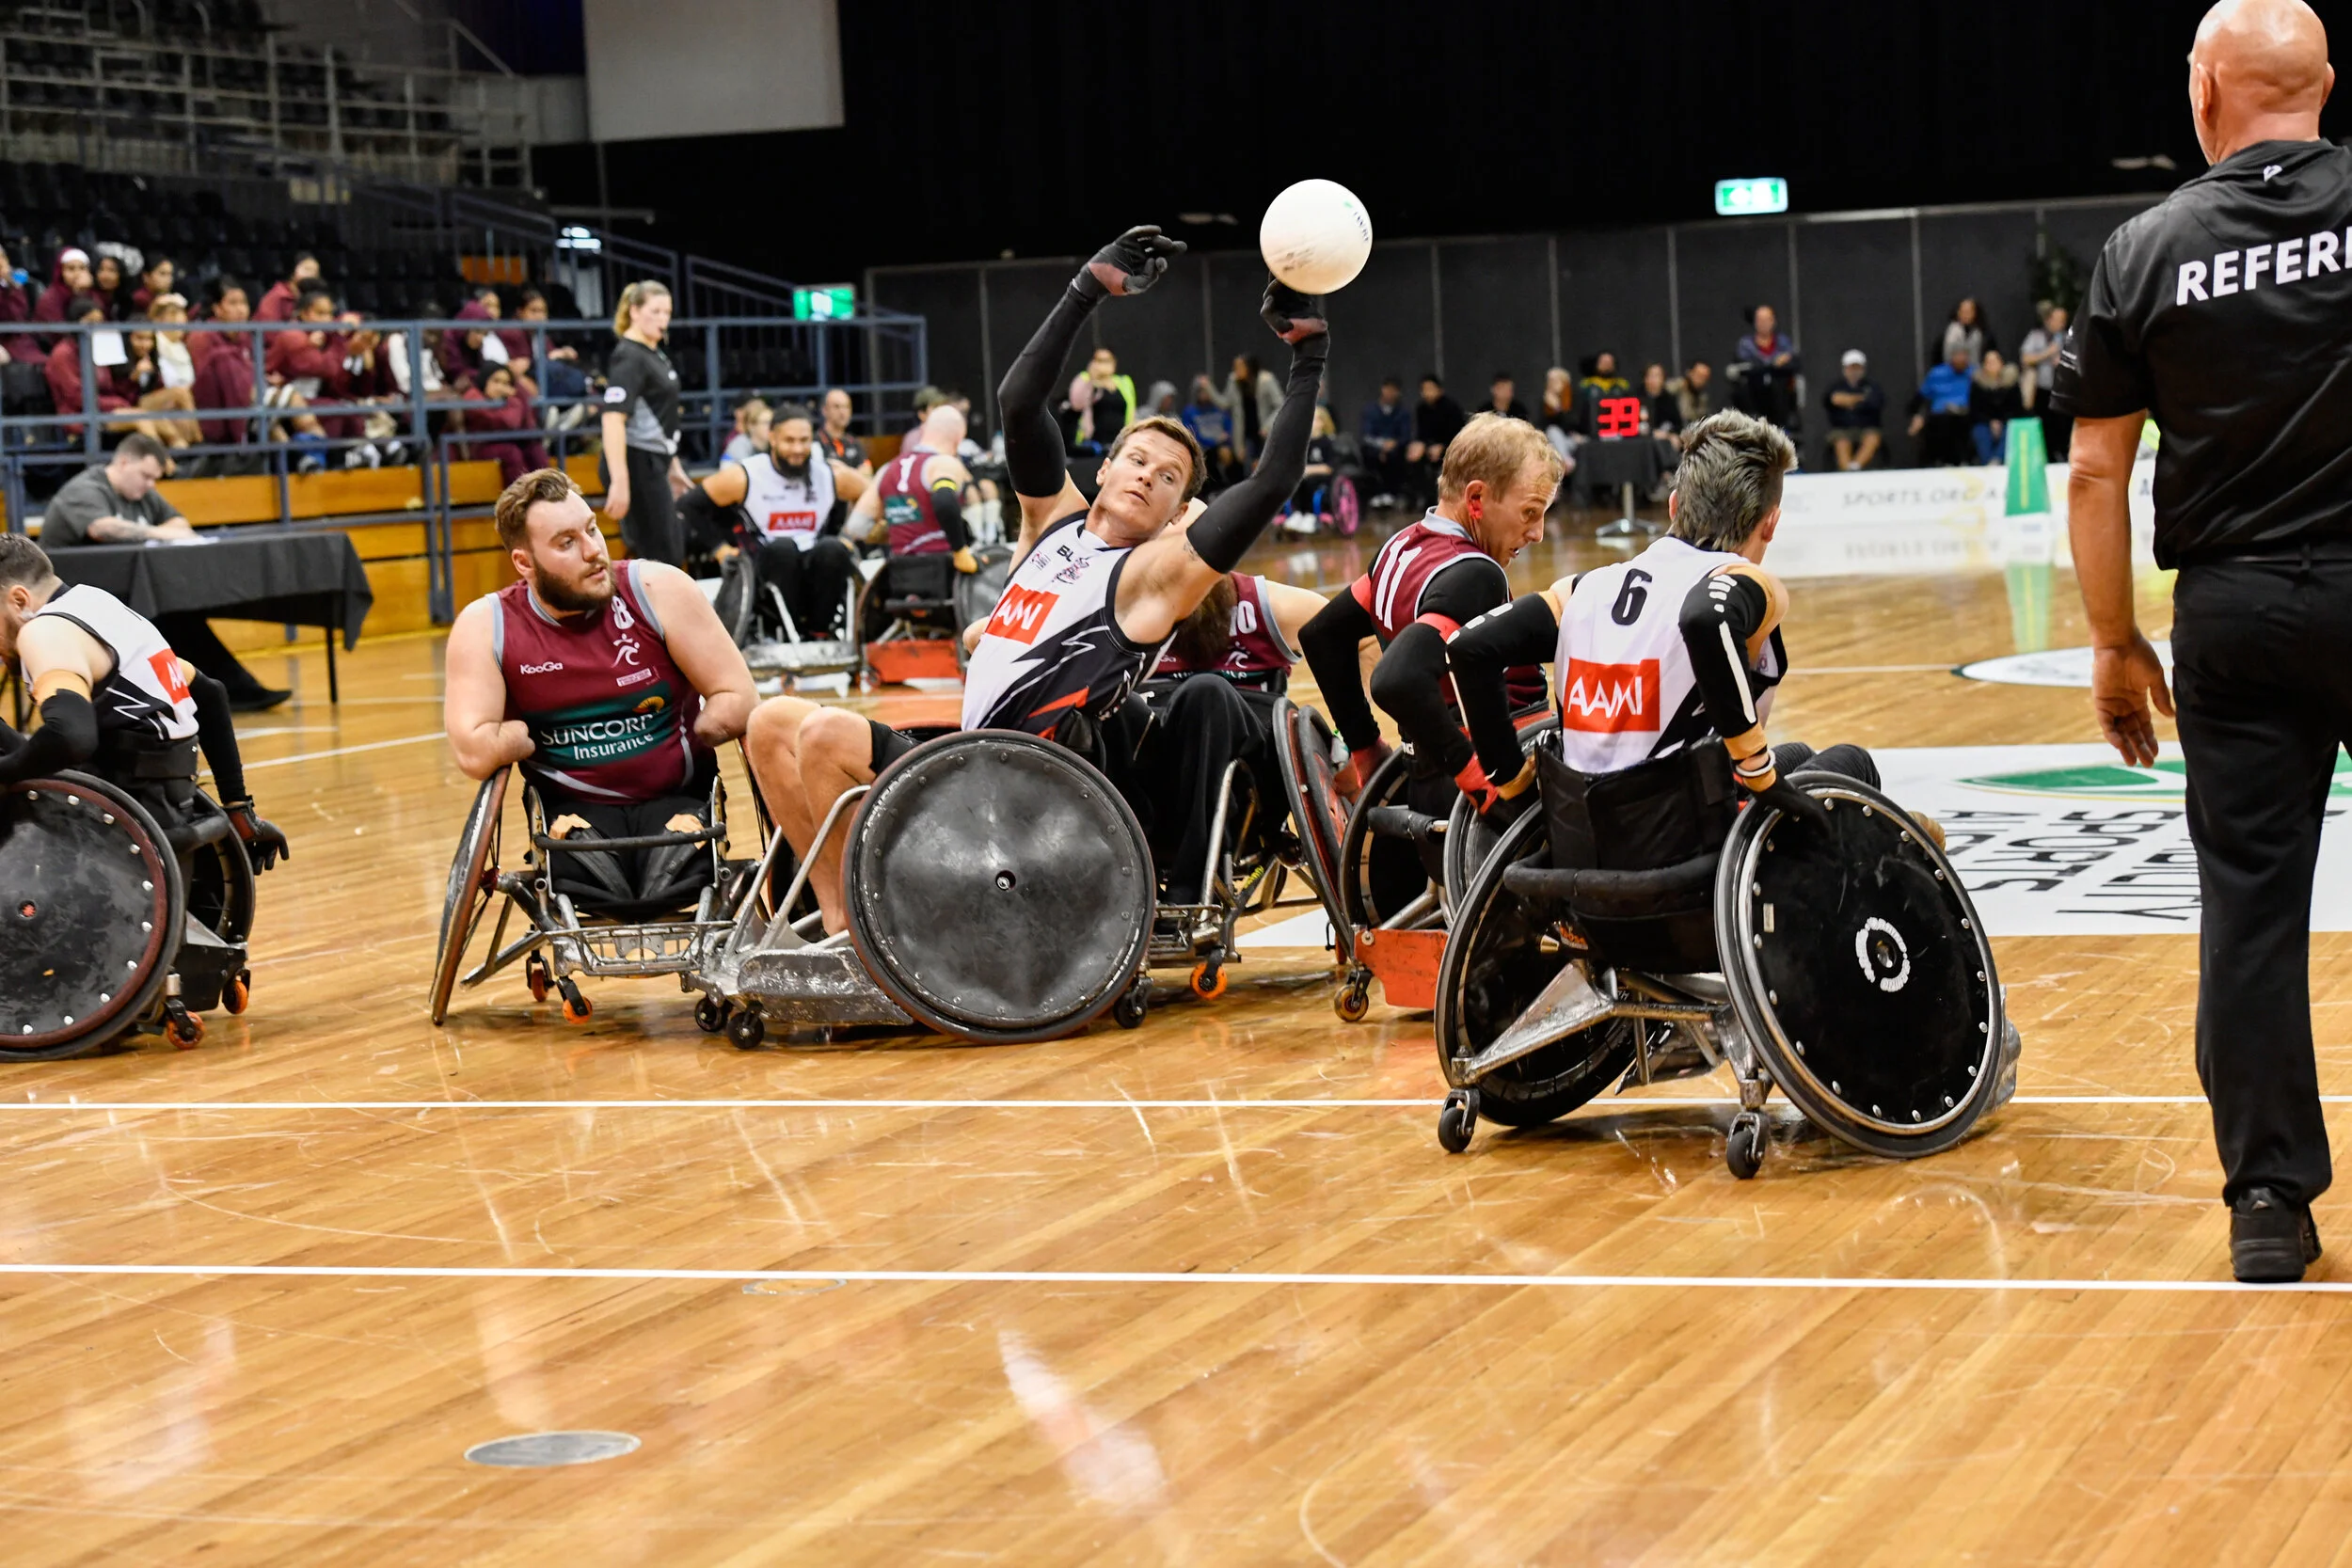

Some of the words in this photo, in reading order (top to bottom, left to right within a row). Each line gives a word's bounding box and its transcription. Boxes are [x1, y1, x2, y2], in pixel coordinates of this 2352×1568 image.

[2175, 225, 2352, 307] REFER
[1597, 397, 1641, 437] 39
[896, 454, 917, 493] 1
[1375, 534, 1422, 632] 11
[1611, 567, 1653, 626] 6
[612, 594, 636, 630] 8
[519, 661, 564, 675] KooGa
[1566, 674, 1644, 720] AAMI
[573, 733, 655, 761] Insurance
